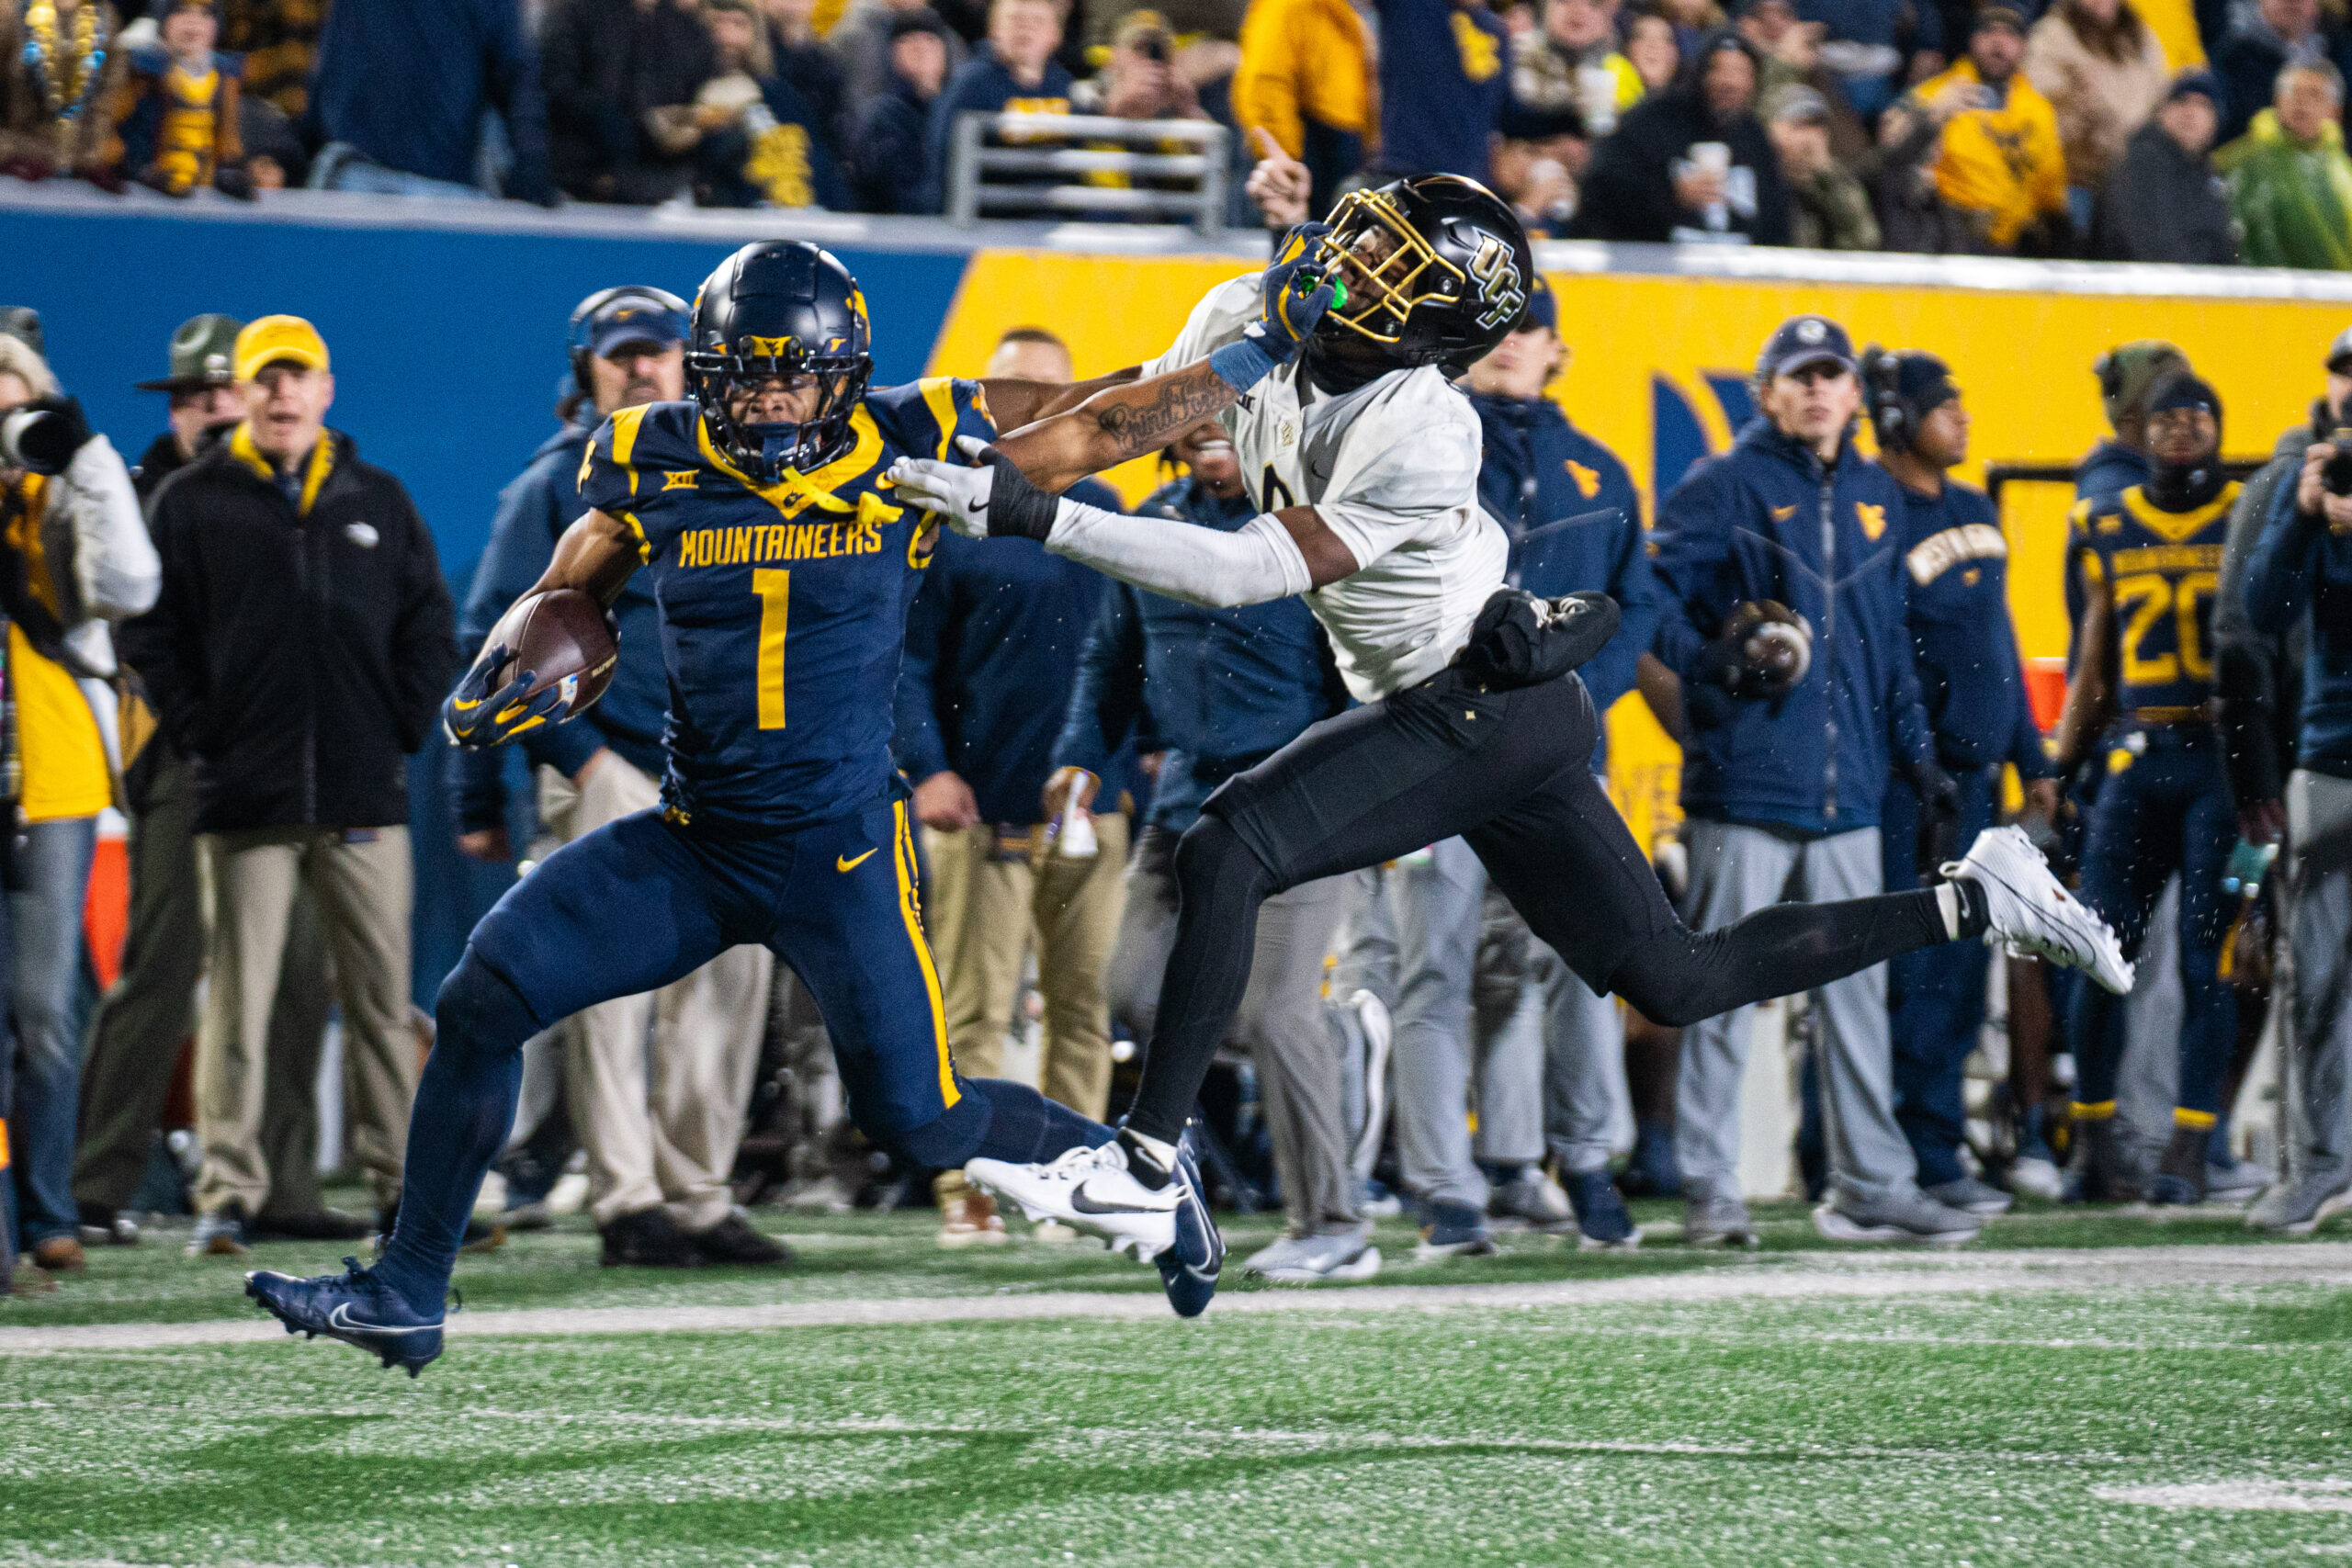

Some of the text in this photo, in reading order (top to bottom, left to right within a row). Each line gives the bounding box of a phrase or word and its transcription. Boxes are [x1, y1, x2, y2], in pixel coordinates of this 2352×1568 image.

[1467, 227, 1525, 329] UCF
[678, 522, 883, 568] MOUNTAINEERS
[752, 568, 791, 730] 1
